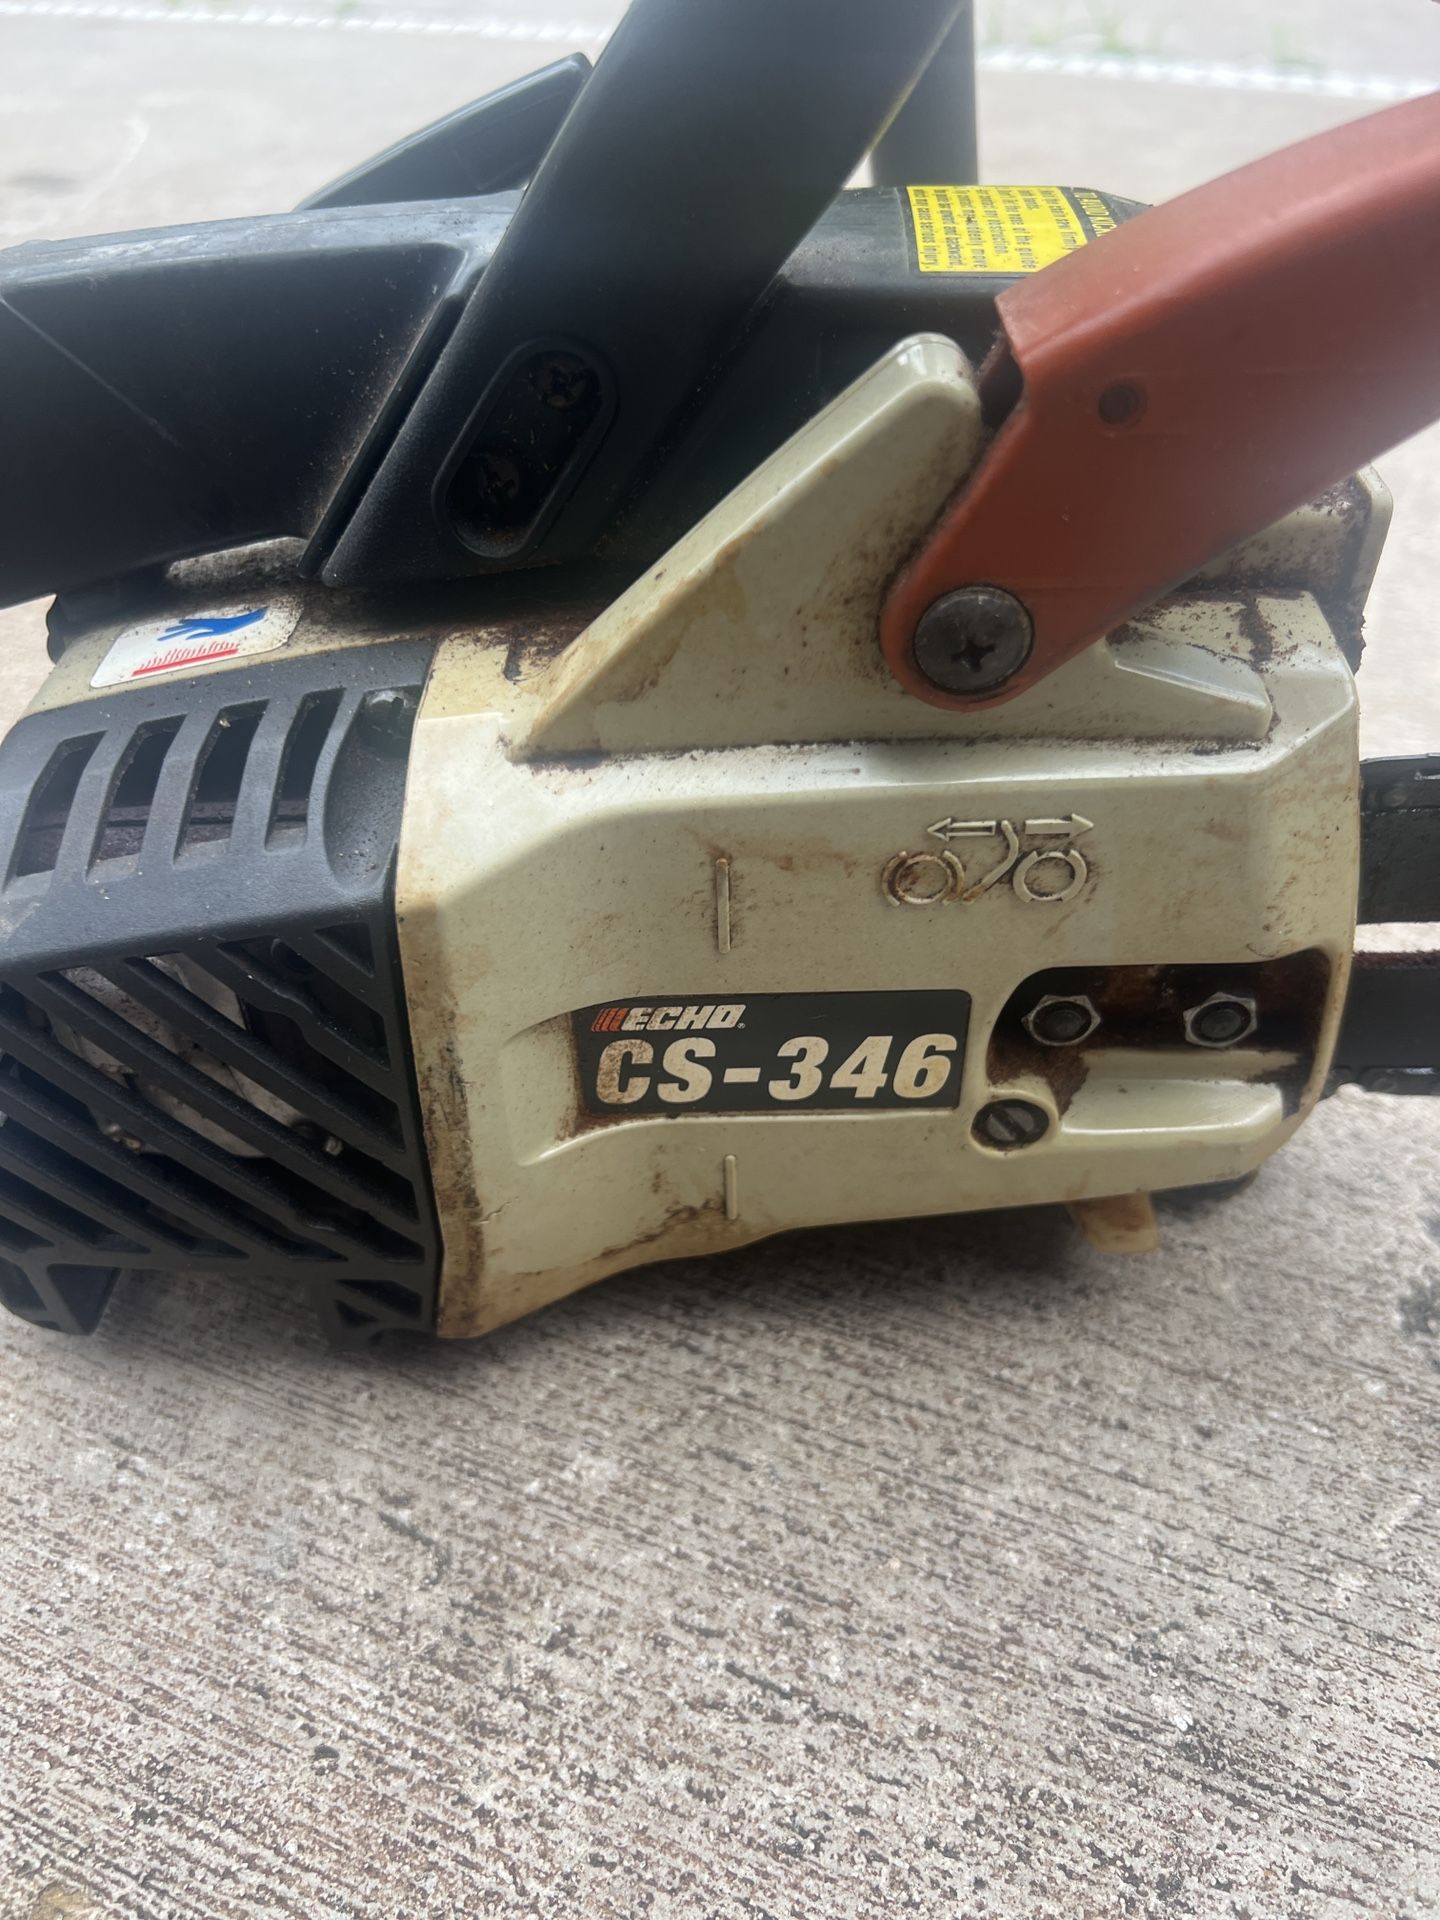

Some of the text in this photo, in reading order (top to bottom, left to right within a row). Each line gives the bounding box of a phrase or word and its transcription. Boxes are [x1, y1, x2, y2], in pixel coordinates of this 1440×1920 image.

[1077, 198, 1109, 215] AVOID
[920, 222, 937, 241] serious
[986, 219, 1011, 255] obstruction.
[919, 246, 940, 267] injury.
[944, 237, 967, 268] backward,
[970, 250, 989, 267] move
[1014, 247, 1042, 269] guide
[622, 1004, 746, 1030] ECHO
[596, 1033, 957, 1104] CS-346
